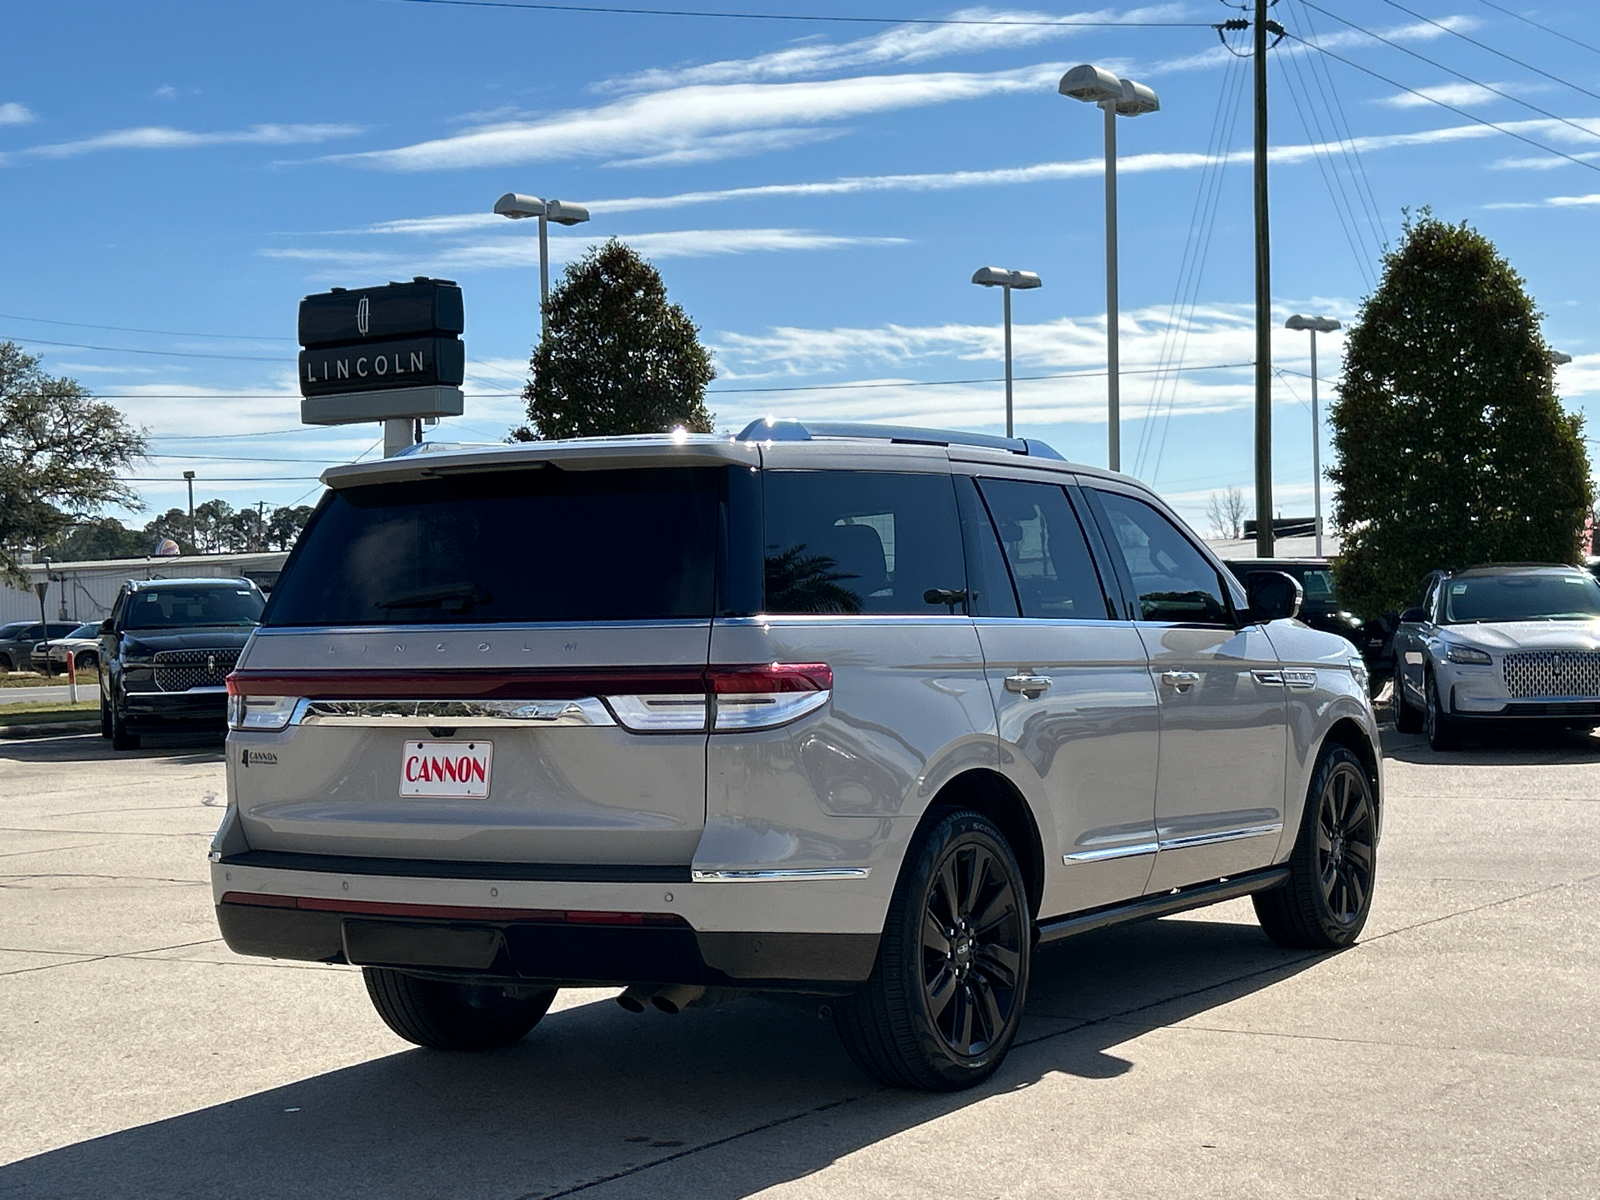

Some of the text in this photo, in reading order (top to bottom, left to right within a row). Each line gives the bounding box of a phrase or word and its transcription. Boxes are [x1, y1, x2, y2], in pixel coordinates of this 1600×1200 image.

[307, 351, 424, 382] LINCOLN
[328, 643, 577, 653] LINCOLN
[250, 752, 278, 761] CANNON
[406, 756, 486, 783] CANNON
